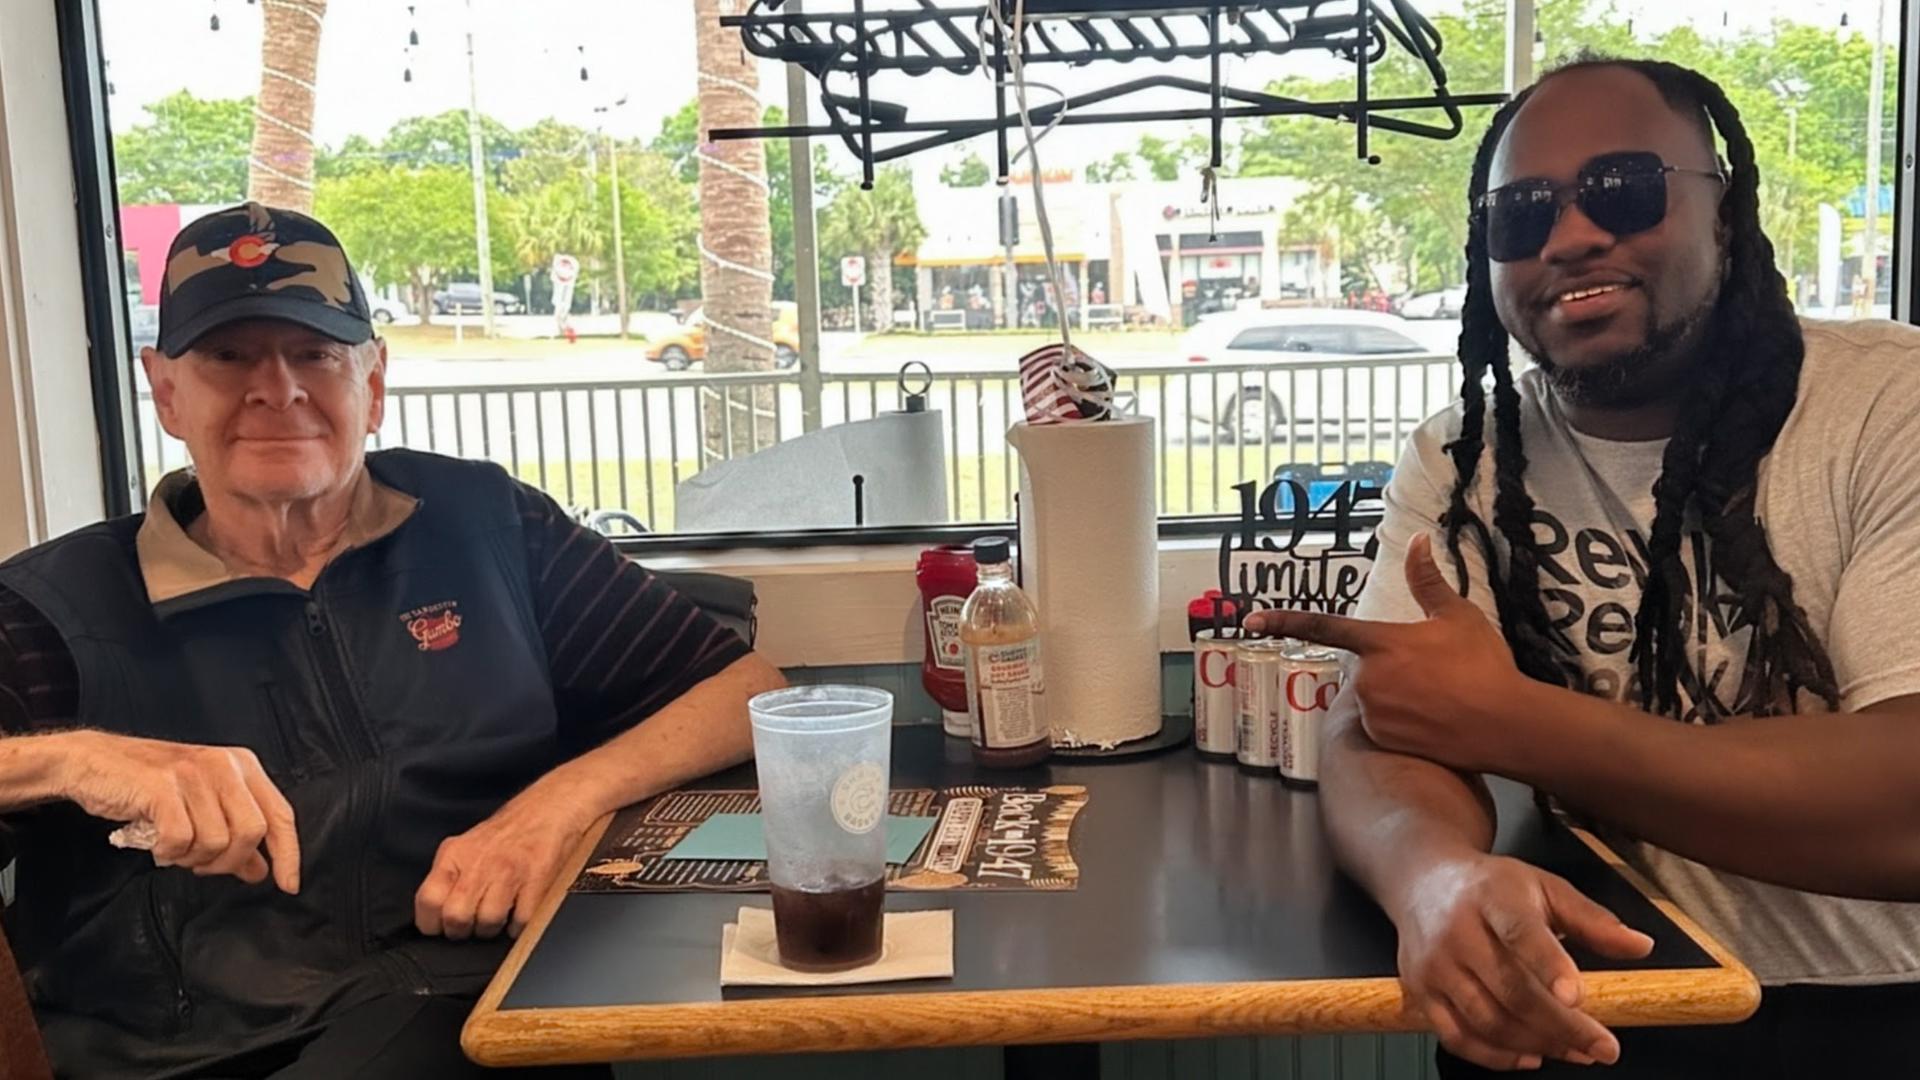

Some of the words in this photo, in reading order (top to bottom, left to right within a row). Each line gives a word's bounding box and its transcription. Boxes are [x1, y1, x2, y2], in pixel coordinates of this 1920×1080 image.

[1219, 532, 1372, 601] Limite
[406, 609, 462, 651] Gumbo
[940, 606, 960, 615] HEIN
[993, 793, 1047, 831] Back
[977, 837, 1037, 881] 1947
